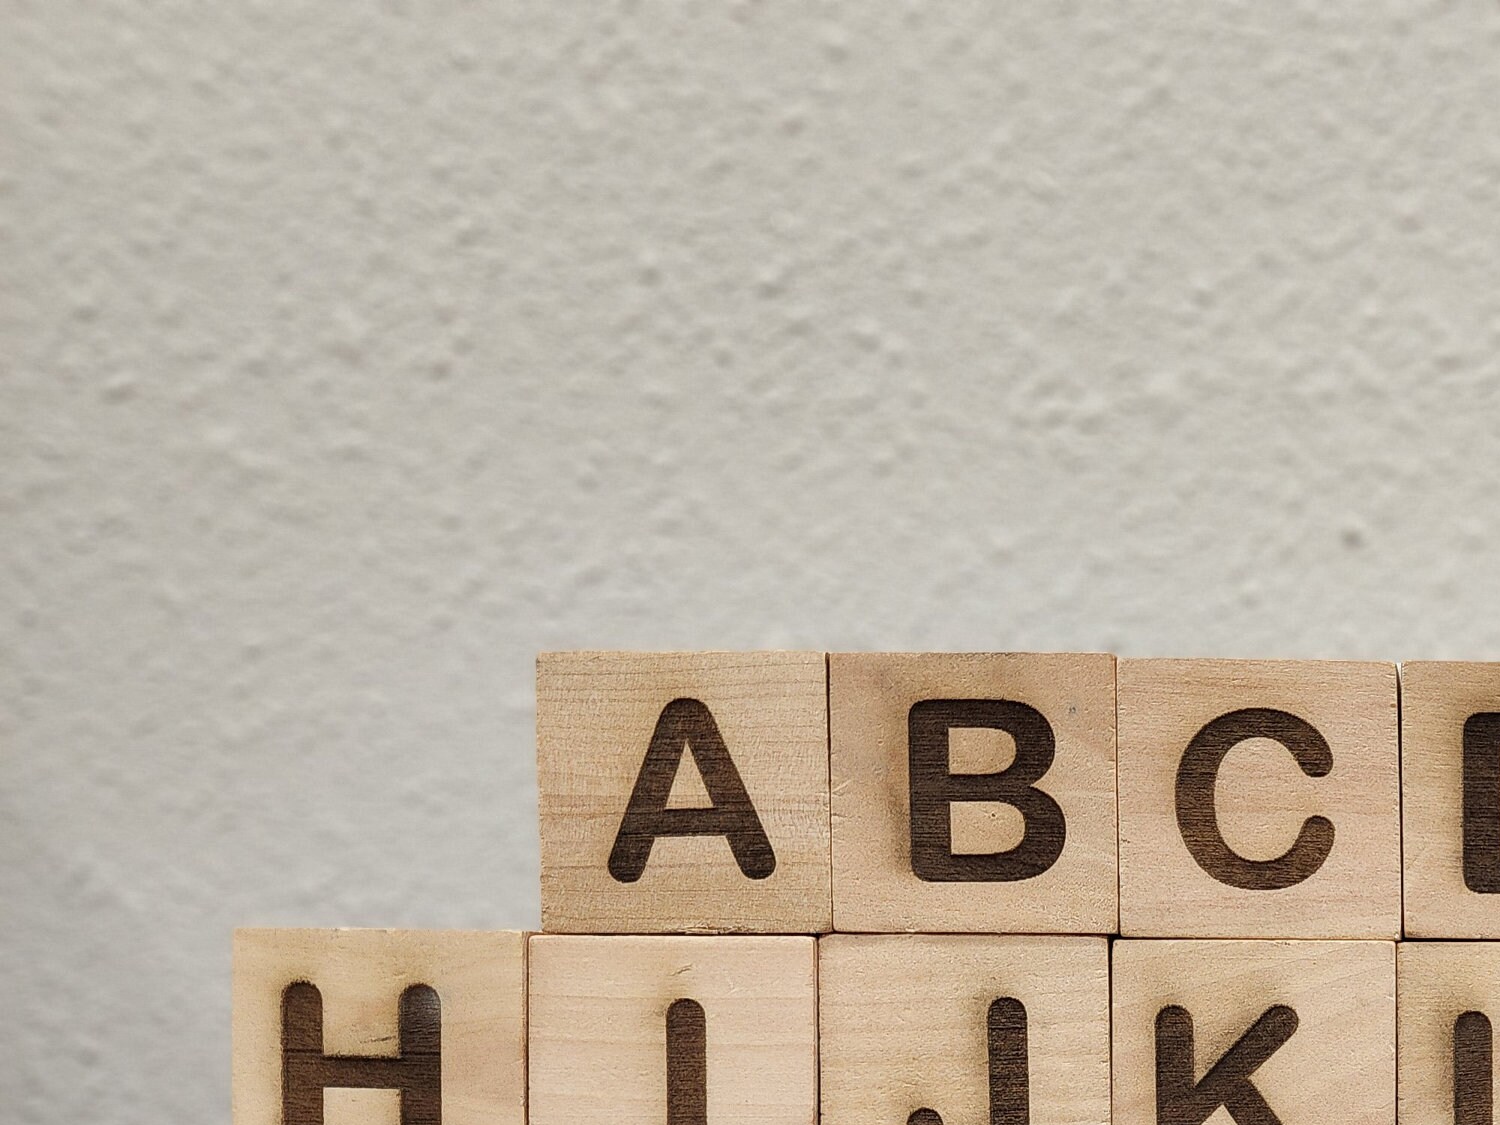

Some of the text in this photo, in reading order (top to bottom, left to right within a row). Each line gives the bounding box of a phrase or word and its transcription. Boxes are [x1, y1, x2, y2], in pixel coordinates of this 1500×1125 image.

[607, 697, 776, 883] A
[907, 698, 1066, 882] B
[1175, 708, 1334, 890] C
